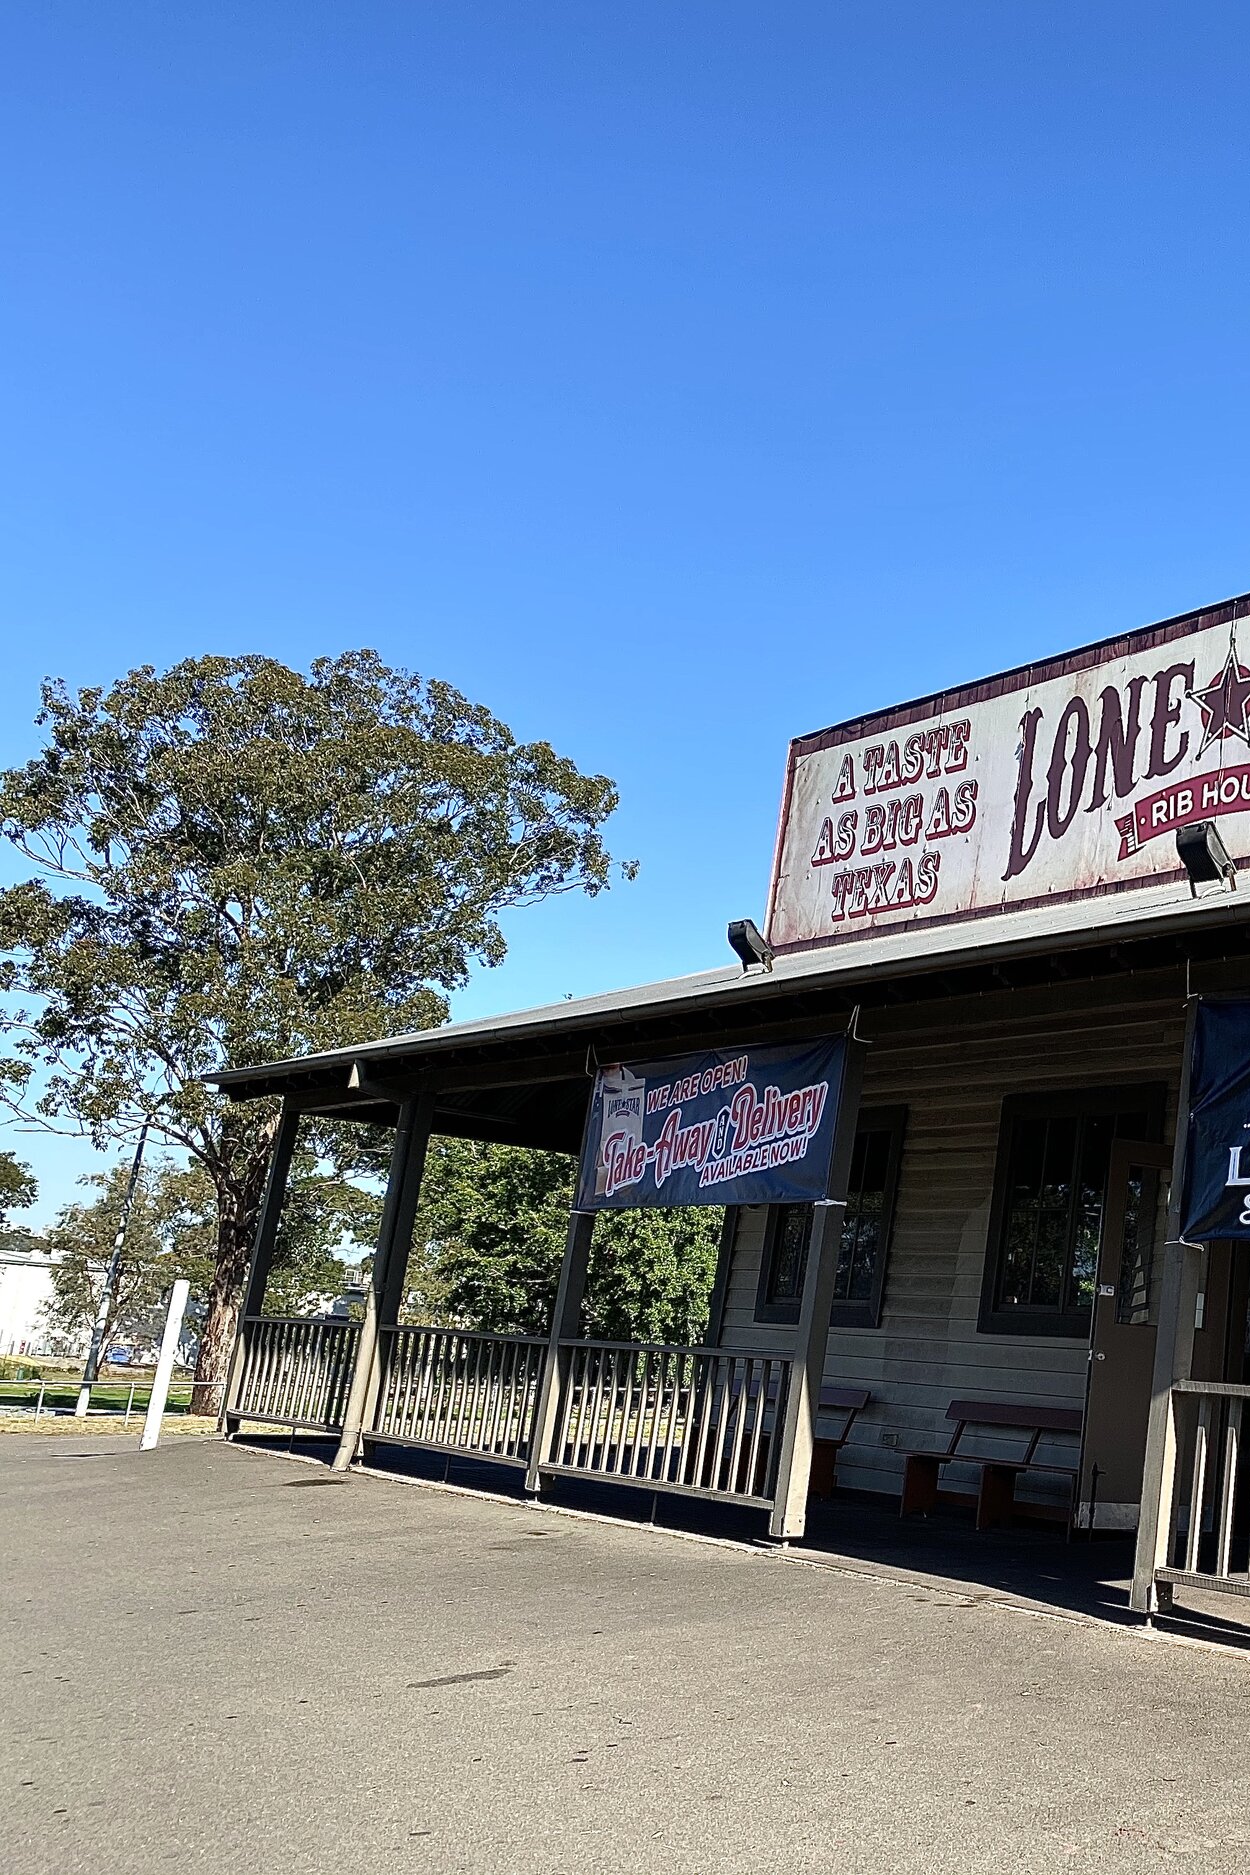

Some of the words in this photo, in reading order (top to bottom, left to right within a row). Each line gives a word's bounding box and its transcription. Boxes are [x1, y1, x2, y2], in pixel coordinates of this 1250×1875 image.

[832, 753, 857, 803] A
[864, 719, 971, 796] TASTE
[1001, 659, 1195, 881] LONE
[811, 810, 858, 867] AS
[861, 793, 923, 856] BIG
[925, 779, 978, 840] AS
[1151, 791, 1193, 828] RIB
[832, 851, 941, 922] TEXAS
[647, 1088, 669, 1115] WE
[669, 1072, 701, 1107] ARE
[701, 1055, 748, 1095] OPEN!
[603, 1108, 716, 1197] Take-Away
[716, 1115, 726, 1151] AND
[730, 1082, 828, 1153] Delivery
[699, 1149, 769, 1187] AVAILABLE
[769, 1137, 808, 1167] NOW!
